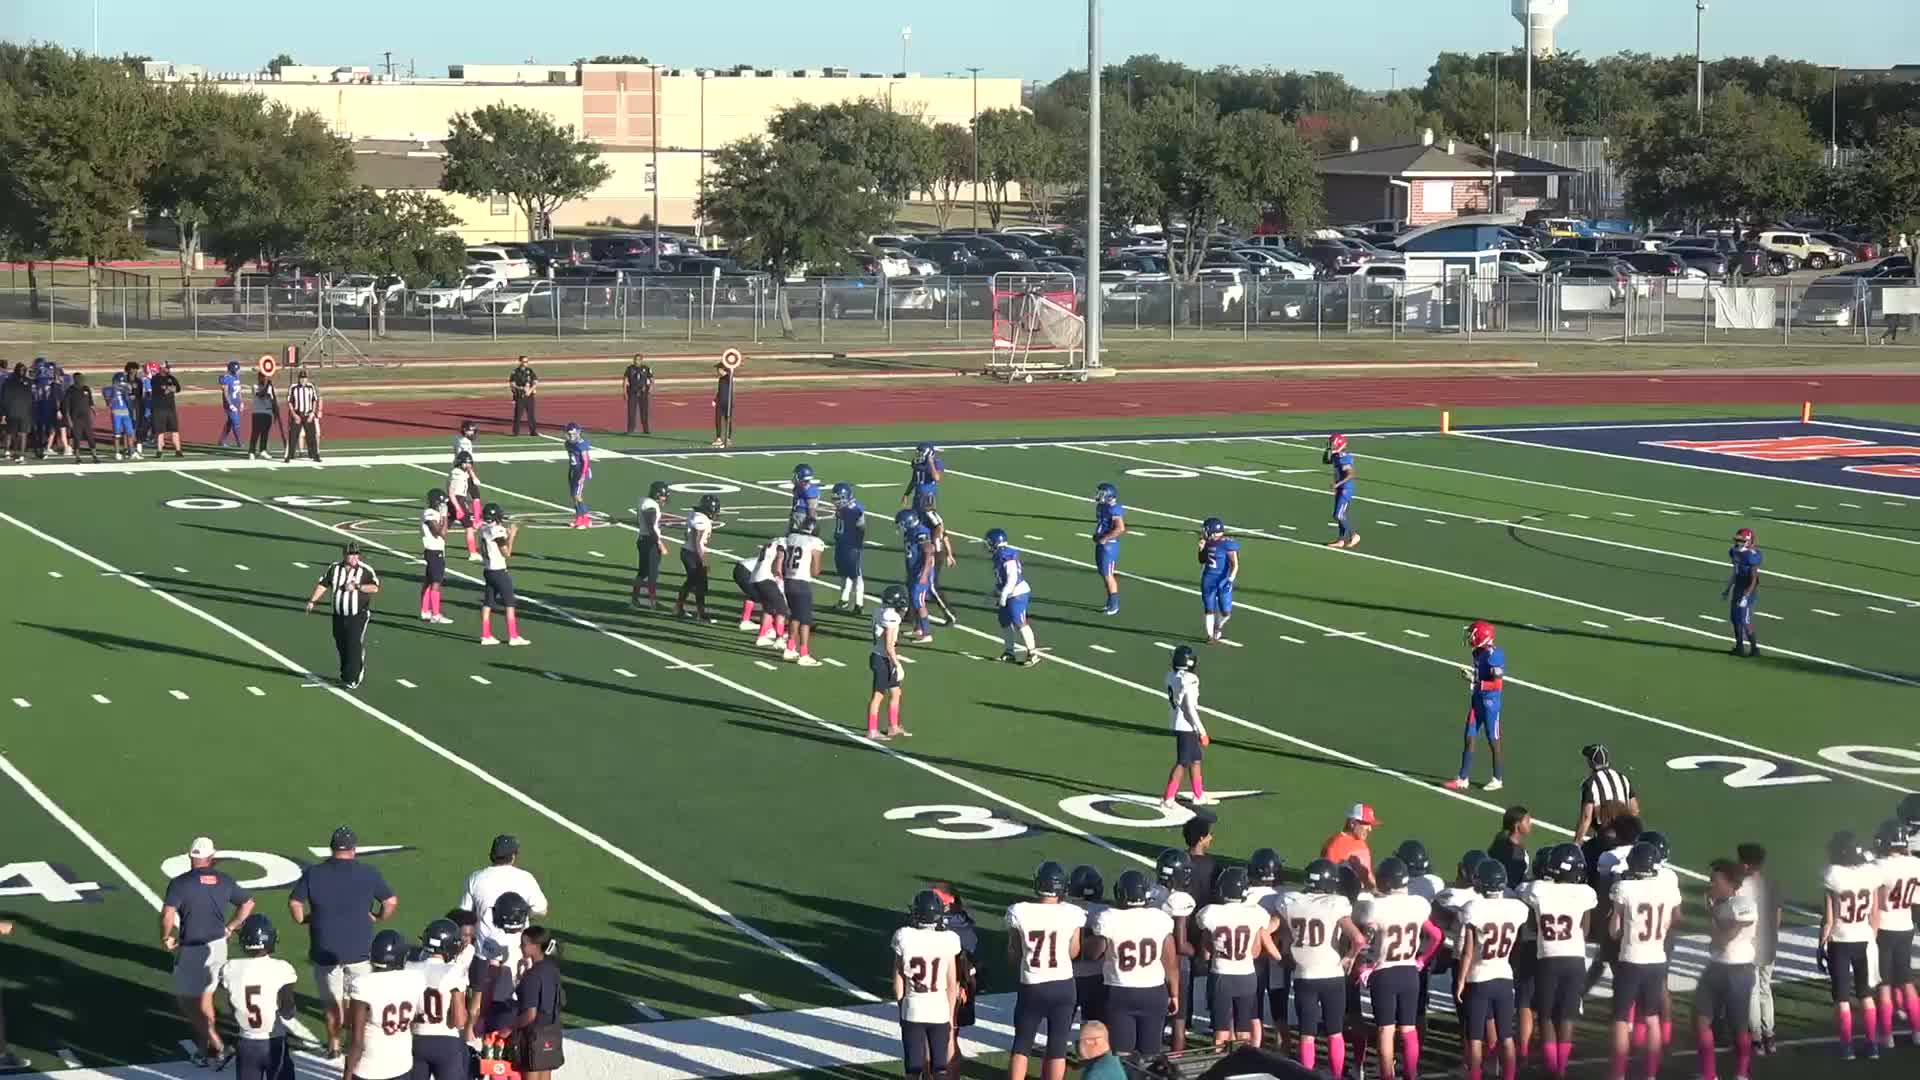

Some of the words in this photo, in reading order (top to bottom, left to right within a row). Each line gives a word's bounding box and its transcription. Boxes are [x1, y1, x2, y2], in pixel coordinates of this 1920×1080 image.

[1637, 902, 1664, 941] 31
[1839, 889, 1871, 923] 32
[1385, 922, 1418, 962] 23
[1482, 921, 1515, 961] 26
[1540, 914, 1573, 941] 63
[1028, 930, 1058, 968] 71
[1117, 938, 1157, 972] 60
[909, 956, 941, 993] 21
[244, 985, 262, 1029] 5
[381, 1001, 413, 1036] 66
